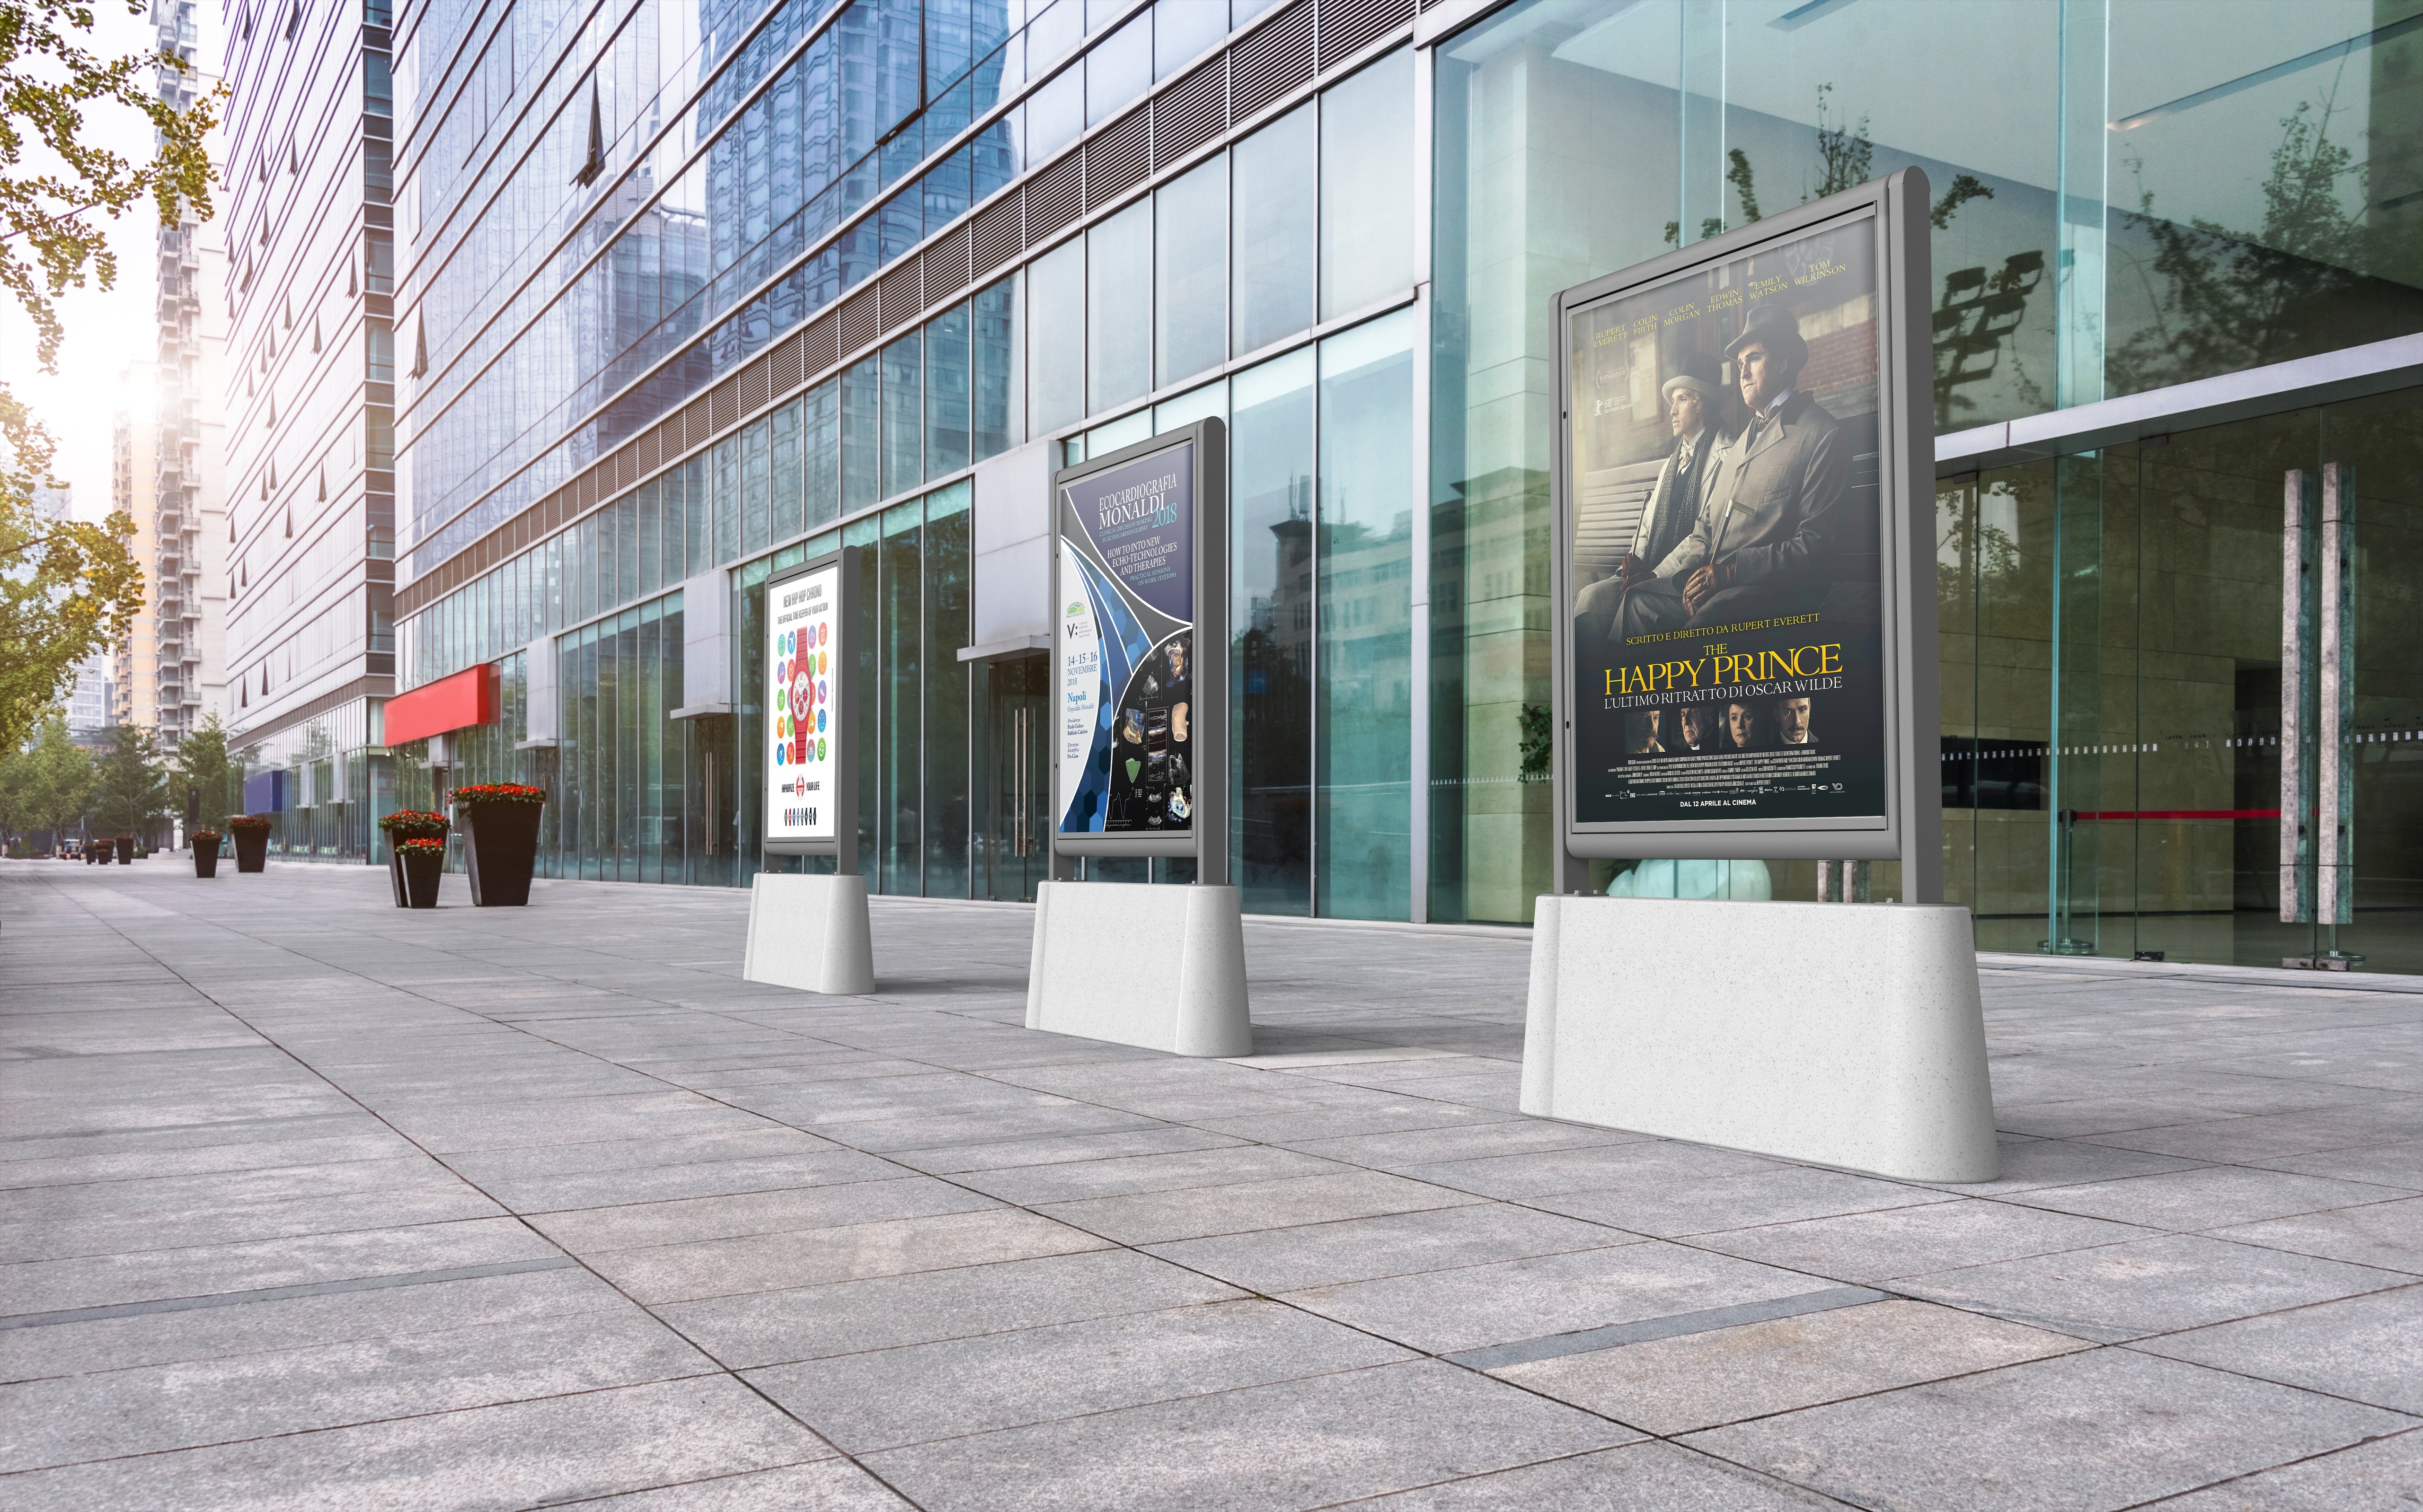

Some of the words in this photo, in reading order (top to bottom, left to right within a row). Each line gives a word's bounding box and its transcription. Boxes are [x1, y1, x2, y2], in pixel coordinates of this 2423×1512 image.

[1809, 260, 1831, 273] TOM
[1754, 275, 1782, 290] EMILY
[1794, 264, 1847, 286] WILKINSON
[1710, 289, 1739, 304] EDWIN
[1749, 282, 1788, 299] WATSON
[1669, 303, 1694, 317] COLIN
[1707, 296, 1742, 313] THOMAS
[1633, 314, 1657, 328] COLIN
[1663, 309, 1700, 327] MORGAN
[1595, 325, 1627, 340] RUPERT
[1634, 322, 1657, 336] FIRTH
[1593, 332, 1628, 349] EVERETT
[1599, 370, 1626, 382] sundance
[1604, 406, 1620, 414] Berlinale
[1620, 401, 1633, 410] Special
[1099, 473, 1177, 512] ECOCARDIOGRAFIA
[1099, 492, 1165, 530] MONALDI
[1152, 502, 1177, 528] 2018
[1099, 527, 1117, 537] CLINICAL
[1117, 523, 1135, 534] DECISION
[1136, 517, 1152, 528] MAKING
[1107, 525, 1148, 542] ECHOCARDIOGRAPHY
[1107, 546, 1121, 559] HOW
[1122, 545, 1130, 554] TO
[1131, 540, 1146, 552] INTO
[1146, 536, 1161, 547] NEW
[1112, 542, 1177, 568] ECHO-TECHNOLOGIES
[1120, 564, 1133, 576] AND
[1133, 556, 1166, 573] THERAPIES
[1130, 571, 1150, 582] PRACTICAL
[1151, 566, 1170, 577] SESSIONS
[1144, 576, 1157, 585] WORK
[1157, 571, 1177, 582] STATIONS
[783, 594, 791, 608] NEW
[807, 584, 822, 601] CHRONO
[782, 613, 792, 624] OFFICIAL
[799, 608, 808, 618] KEEPER
[808, 607, 812, 616] OF
[819, 602, 828, 613] ACTION
[1626, 633, 1664, 646] SCRITTO
[1665, 632, 1671, 641] E
[1673, 625, 1714, 640] DIRETTO
[1716, 624, 1729, 635] DA
[1731, 619, 1771, 633] RUPERT
[1773, 613, 1821, 627] EVERETT
[1703, 643, 1728, 656] THE
[1068, 655, 1075, 666] 14
[1079, 652, 1086, 664] 15
[1090, 651, 1097, 662] 16
[1068, 664, 1097, 676] NOVEMBRE
[1604, 657, 1706, 696] HAPPY
[1712, 642, 1843, 685] PRINCE
[1067, 677, 1077, 686] 2018
[1068, 691, 1086, 704] Napoli
[1604, 692, 1660, 710] L'ULTIMO
[1661, 685, 1727, 705] RITRATTO
[1729, 684, 1743, 699] DI
[1745, 680, 1793, 697] OSCAR
[1794, 676, 1843, 693] WILDE
[1068, 705, 1080, 713] Ospedale
[782, 783, 794, 793] HIPHOPIZE
